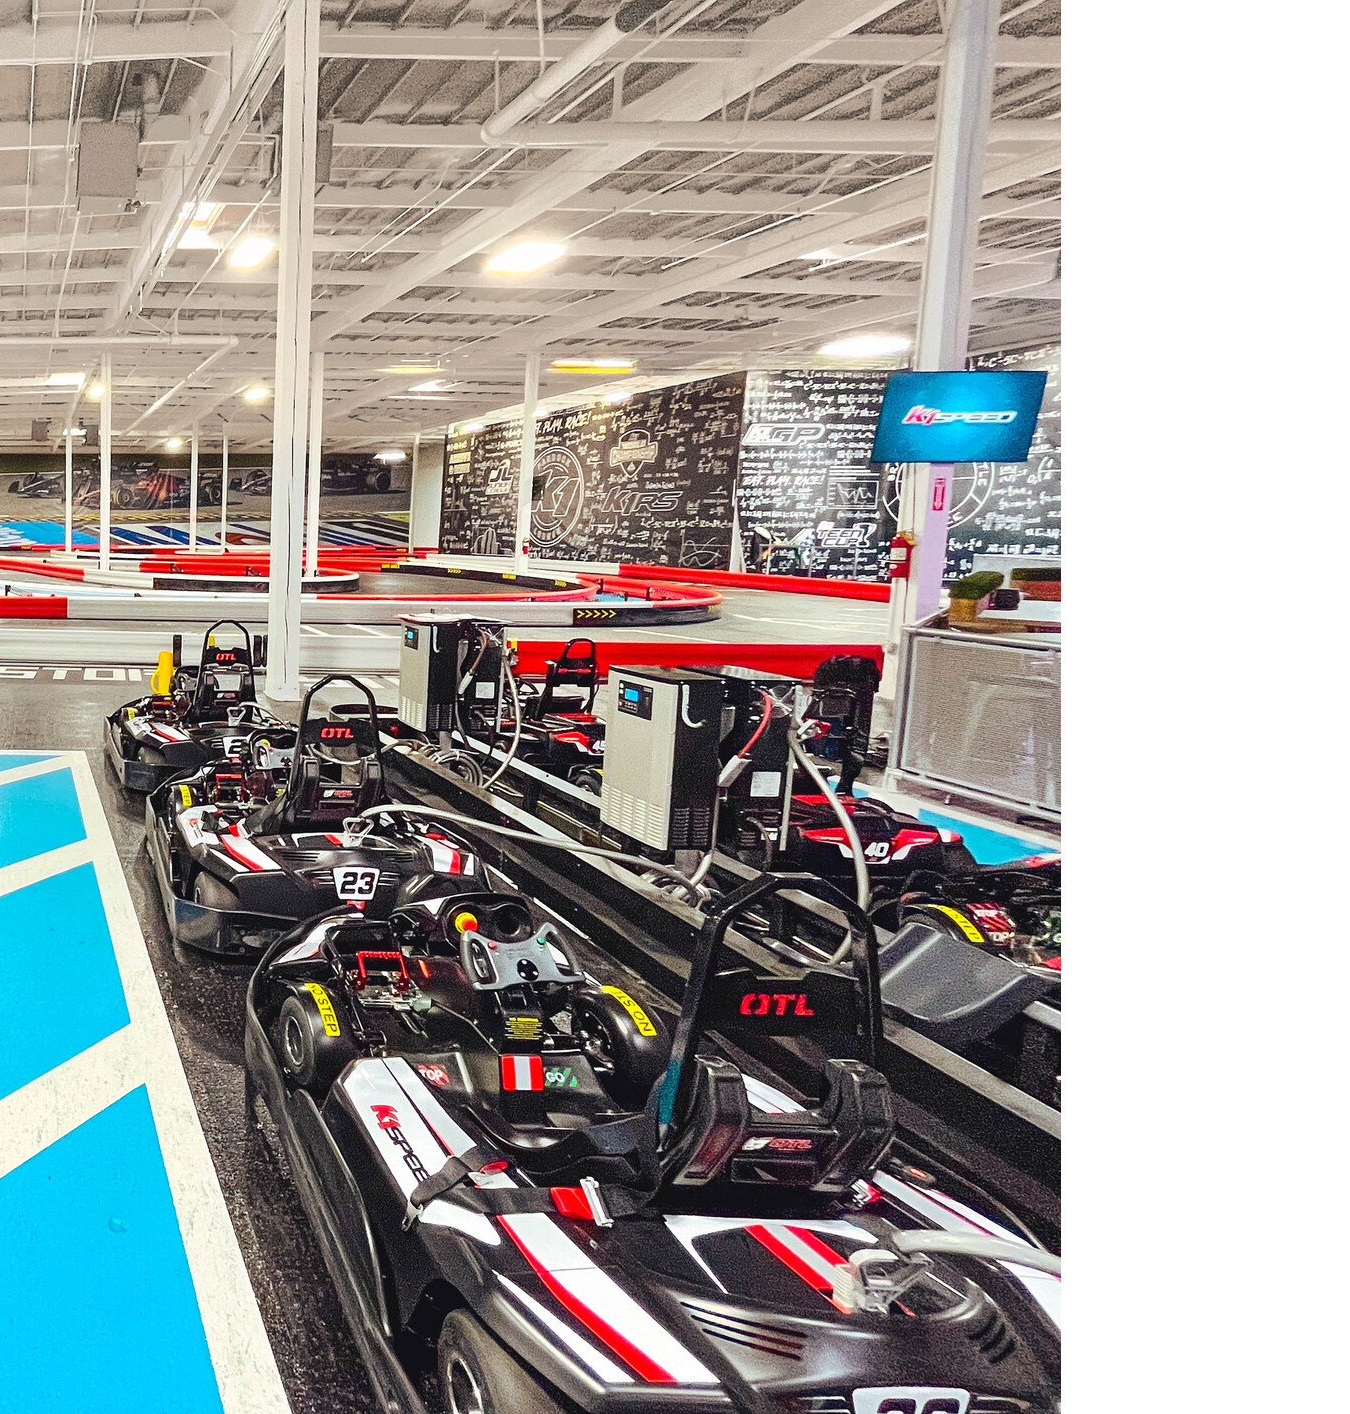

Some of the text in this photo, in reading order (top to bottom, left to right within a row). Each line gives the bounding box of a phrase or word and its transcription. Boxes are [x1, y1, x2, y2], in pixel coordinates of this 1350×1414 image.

[601, 486, 684, 516] K1RS
[320, 727, 355, 739] OTL
[864, 842, 889, 858] 40
[340, 871, 376, 895] 23
[317, 998, 338, 1032] STEP
[739, 993, 816, 1016] OTL
[632, 1011, 653, 1032] NO
[545, 1071, 565, 1083] GO
[383, 1126, 430, 1183] SPEE
